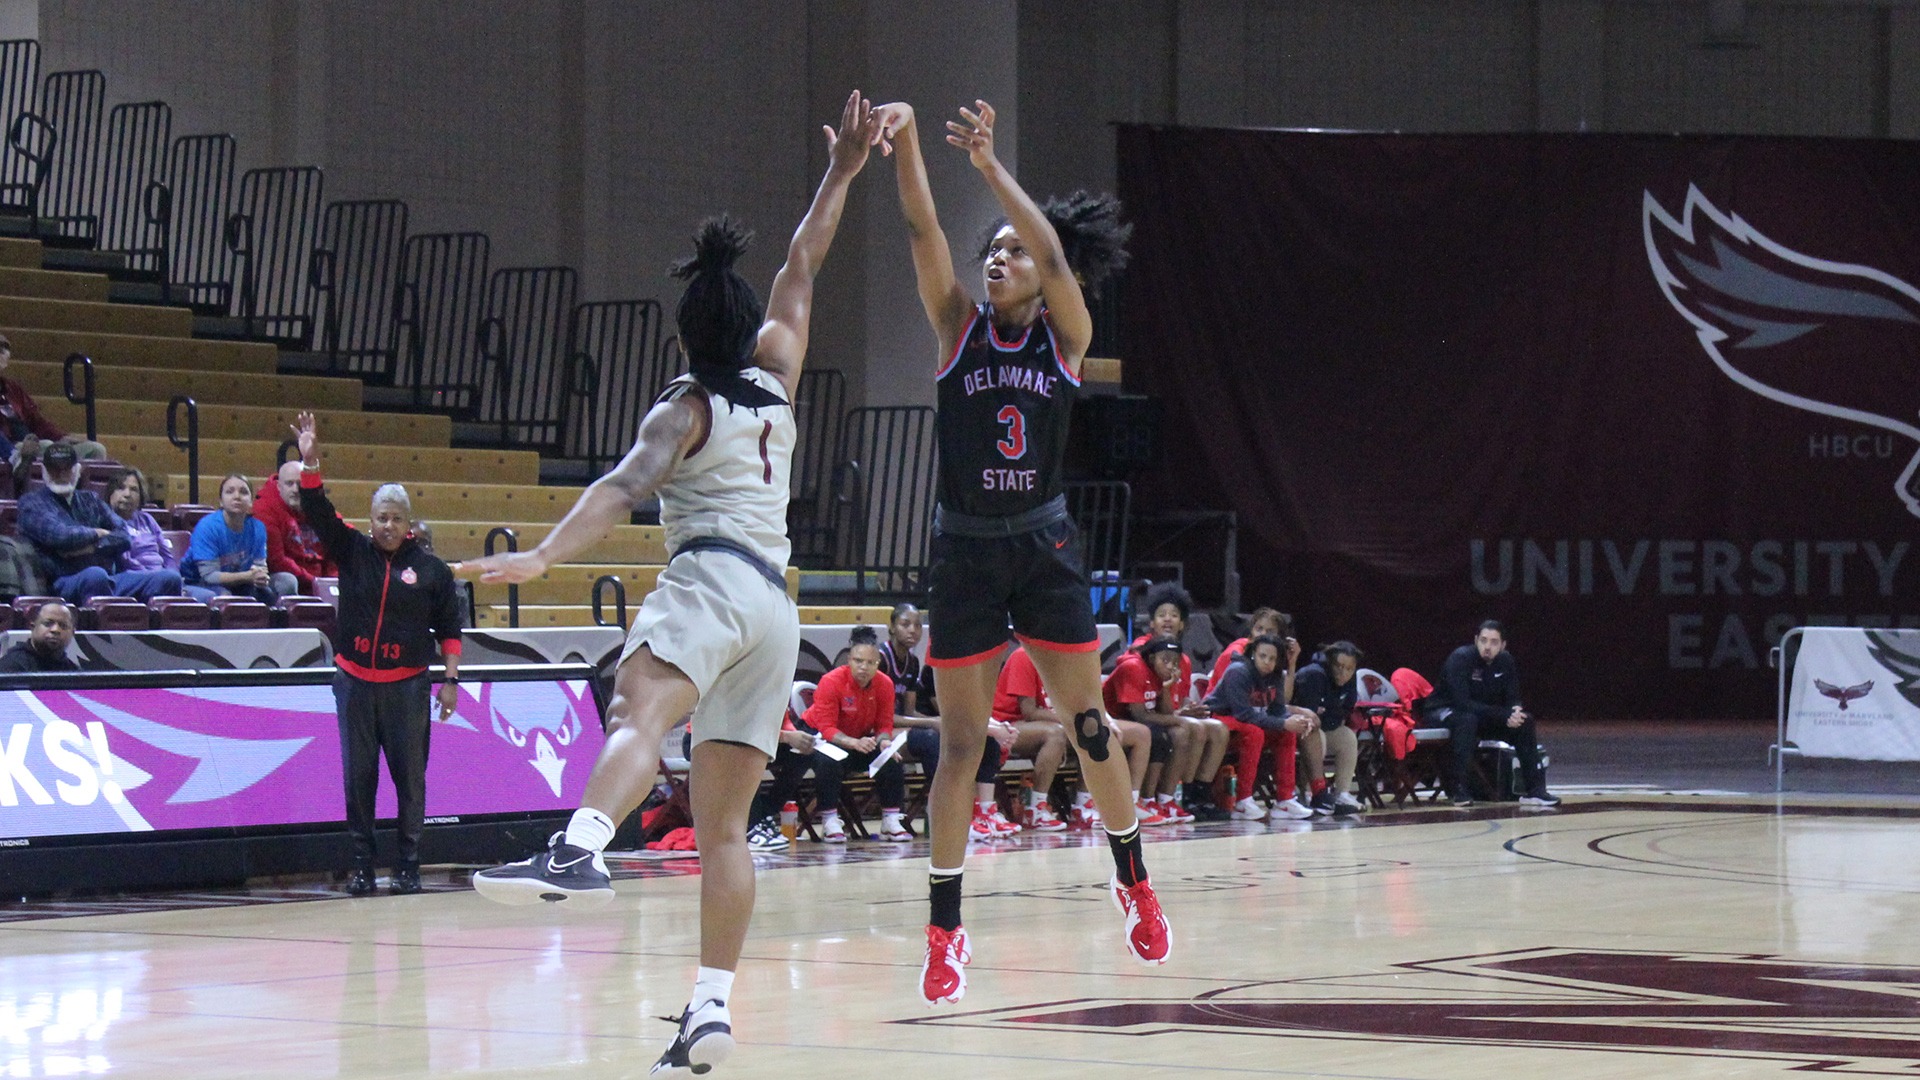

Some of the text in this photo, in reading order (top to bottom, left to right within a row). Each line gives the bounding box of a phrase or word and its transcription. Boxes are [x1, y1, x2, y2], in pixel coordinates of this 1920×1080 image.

[963, 365, 1058, 398] DELAWARE
[759, 419, 772, 485] 1
[997, 405, 1027, 460] 3
[1808, 434, 1893, 459] HBCU
[982, 468, 1037, 491] STATE
[1470, 538, 1910, 597] UNIVERSITY
[354, 635, 401, 659] 19 13
[0, 719, 124, 807] KS!
